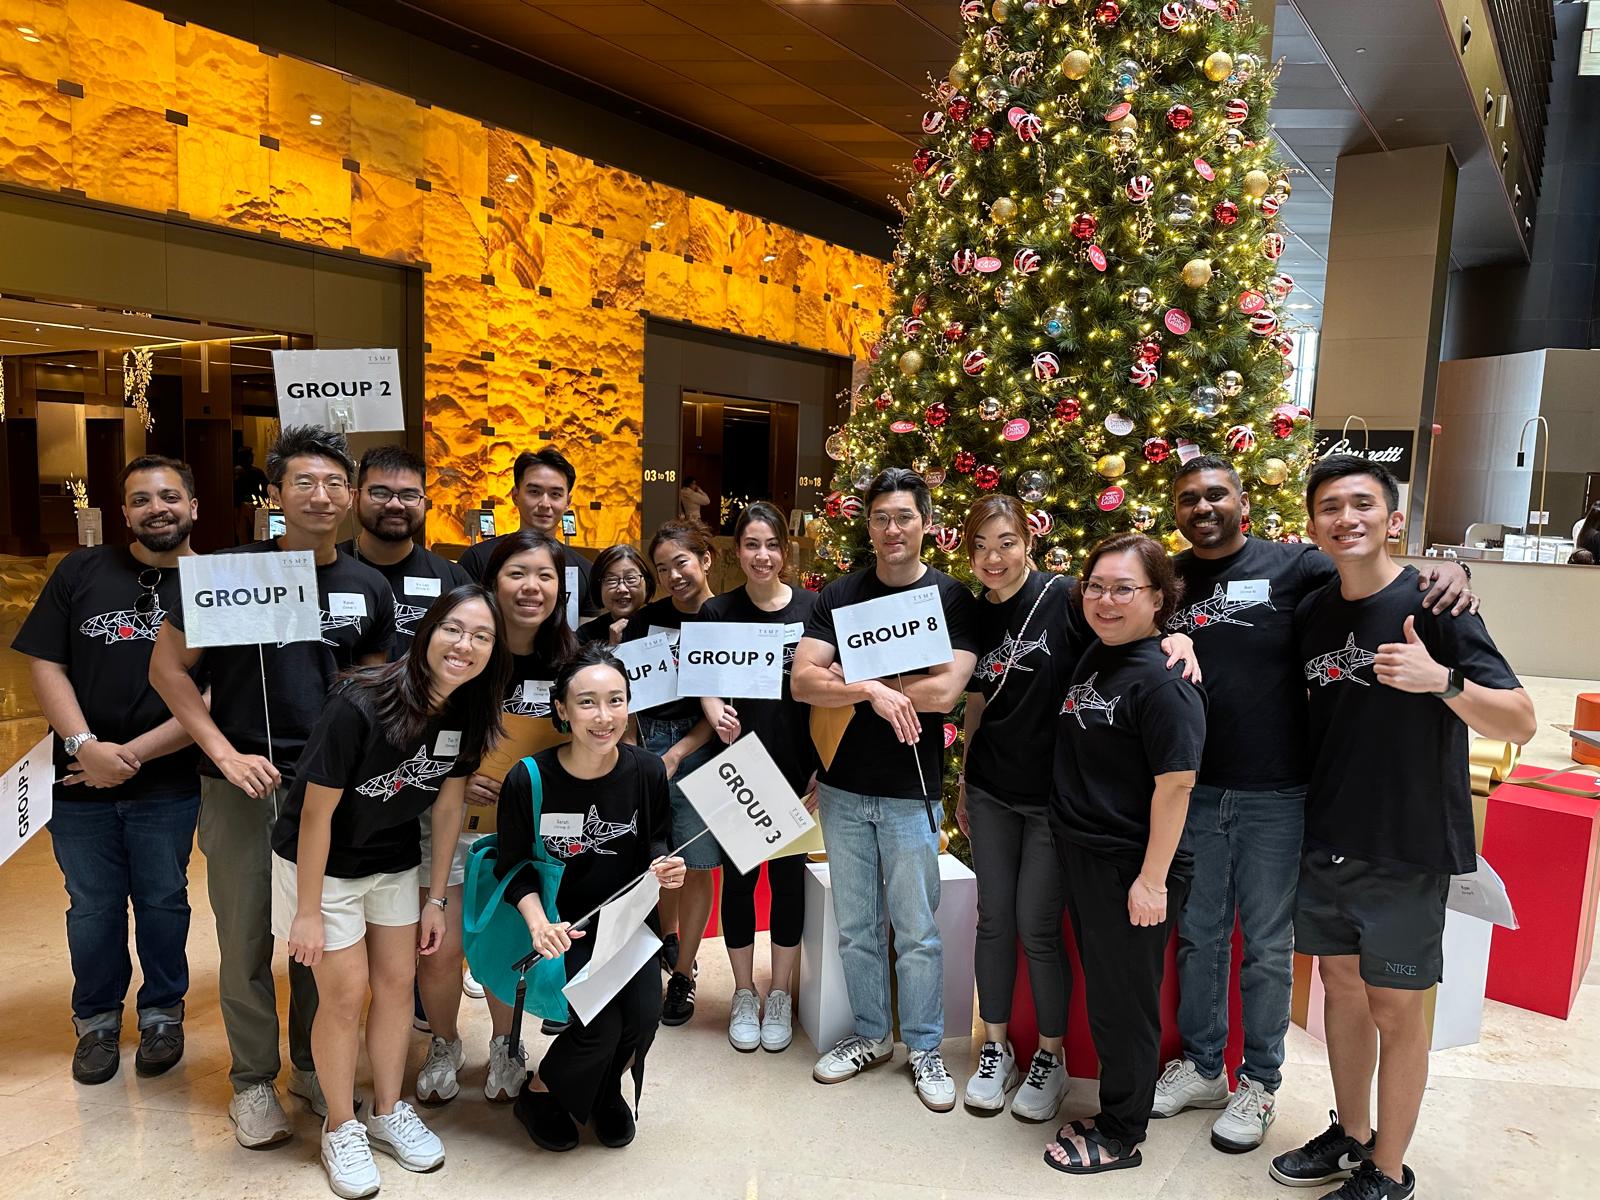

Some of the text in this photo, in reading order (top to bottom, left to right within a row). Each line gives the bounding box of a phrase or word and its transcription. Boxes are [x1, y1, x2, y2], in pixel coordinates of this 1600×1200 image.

[287, 381, 392, 399] GROUP 2
[644, 469, 676, 482] 03 to 18
[799, 476, 808, 486] 03
[814, 476, 821, 487] 18
[194, 586, 288, 608] GROUP
[847, 616, 938, 649] GROUP 8
[688, 650, 775, 666] GROUP 9
[627, 659, 668, 681] UP 4
[18, 760, 29, 837] GROUP 5
[718, 762, 781, 843] GROUP 3
[1385, 961, 1417, 976] NIKE
